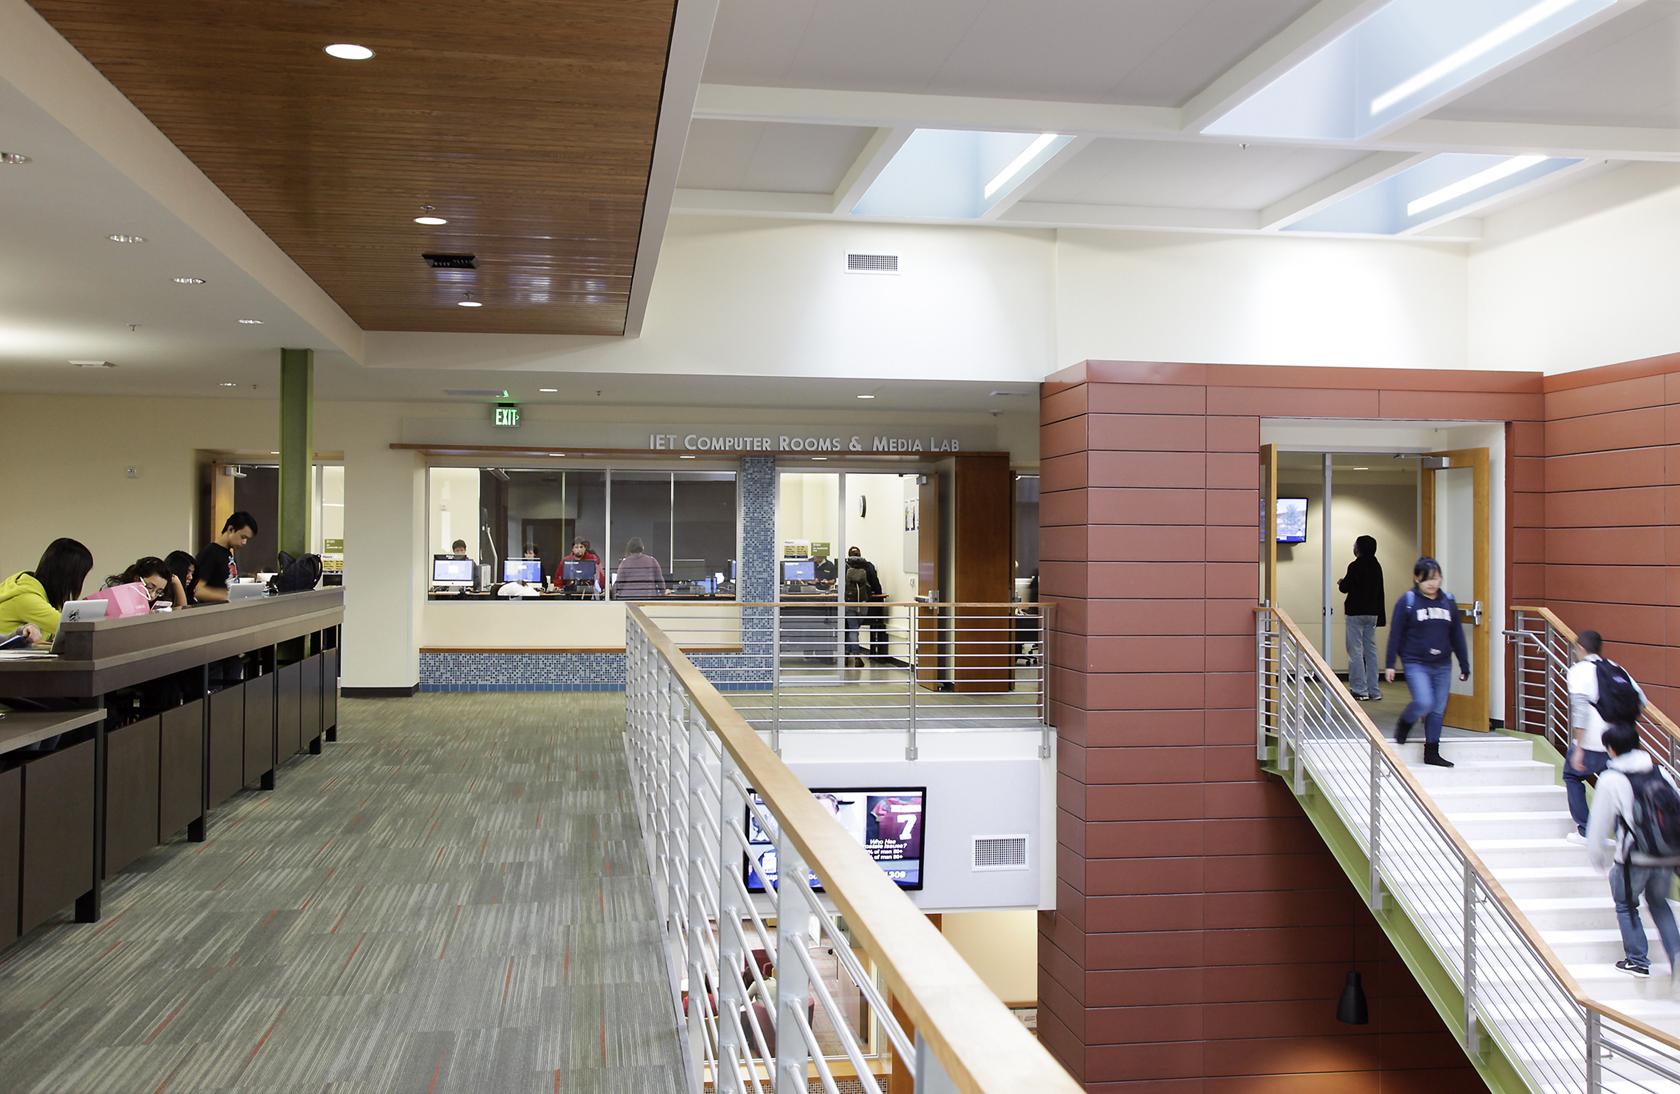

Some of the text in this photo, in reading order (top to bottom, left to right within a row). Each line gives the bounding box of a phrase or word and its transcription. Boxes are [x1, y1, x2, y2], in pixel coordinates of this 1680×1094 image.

[495, 408, 518, 426] EXIT
[649, 434, 960, 452] IET COMPUTER ROOMS & MEDIA LAB
[897, 813, 917, 841] 7
